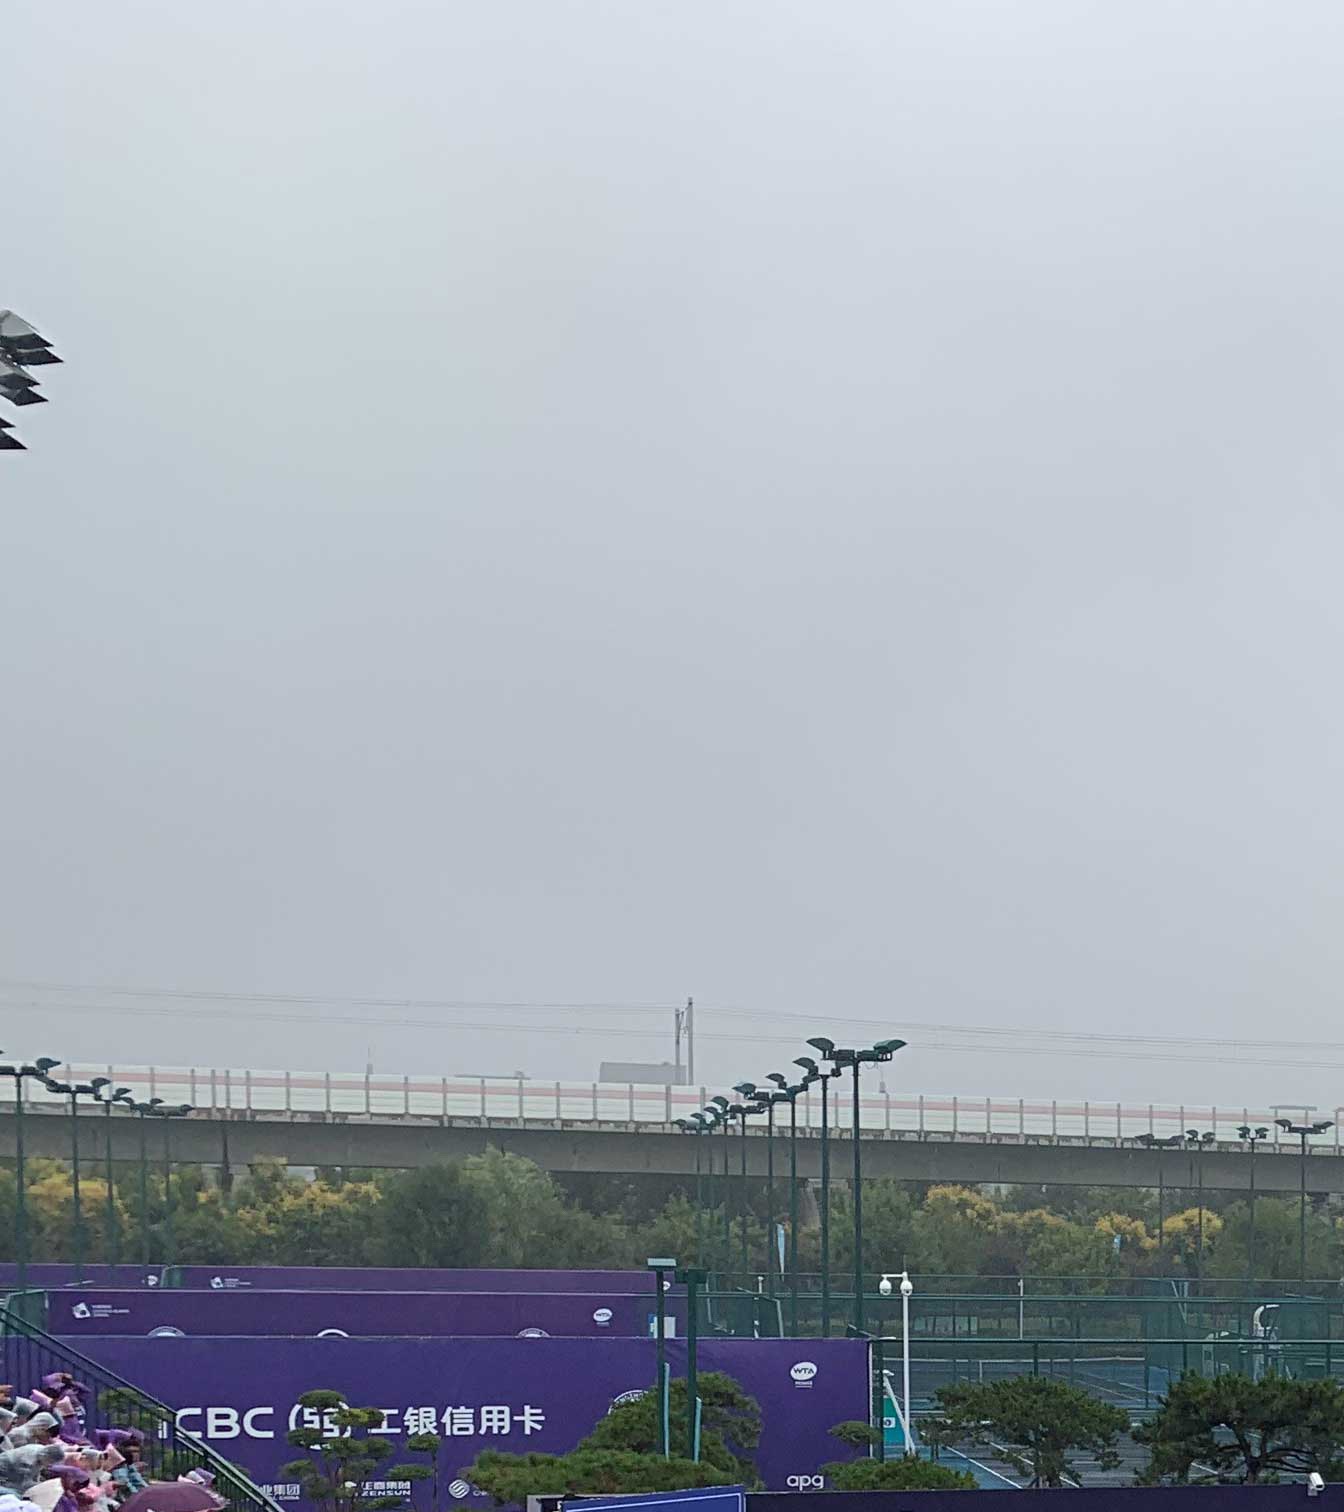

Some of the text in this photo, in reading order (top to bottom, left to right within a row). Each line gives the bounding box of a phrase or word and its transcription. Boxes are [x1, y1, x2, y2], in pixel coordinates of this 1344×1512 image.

[368, 1405, 546, 1436] 工银信用卡
[787, 1475, 824, 1491] apg
